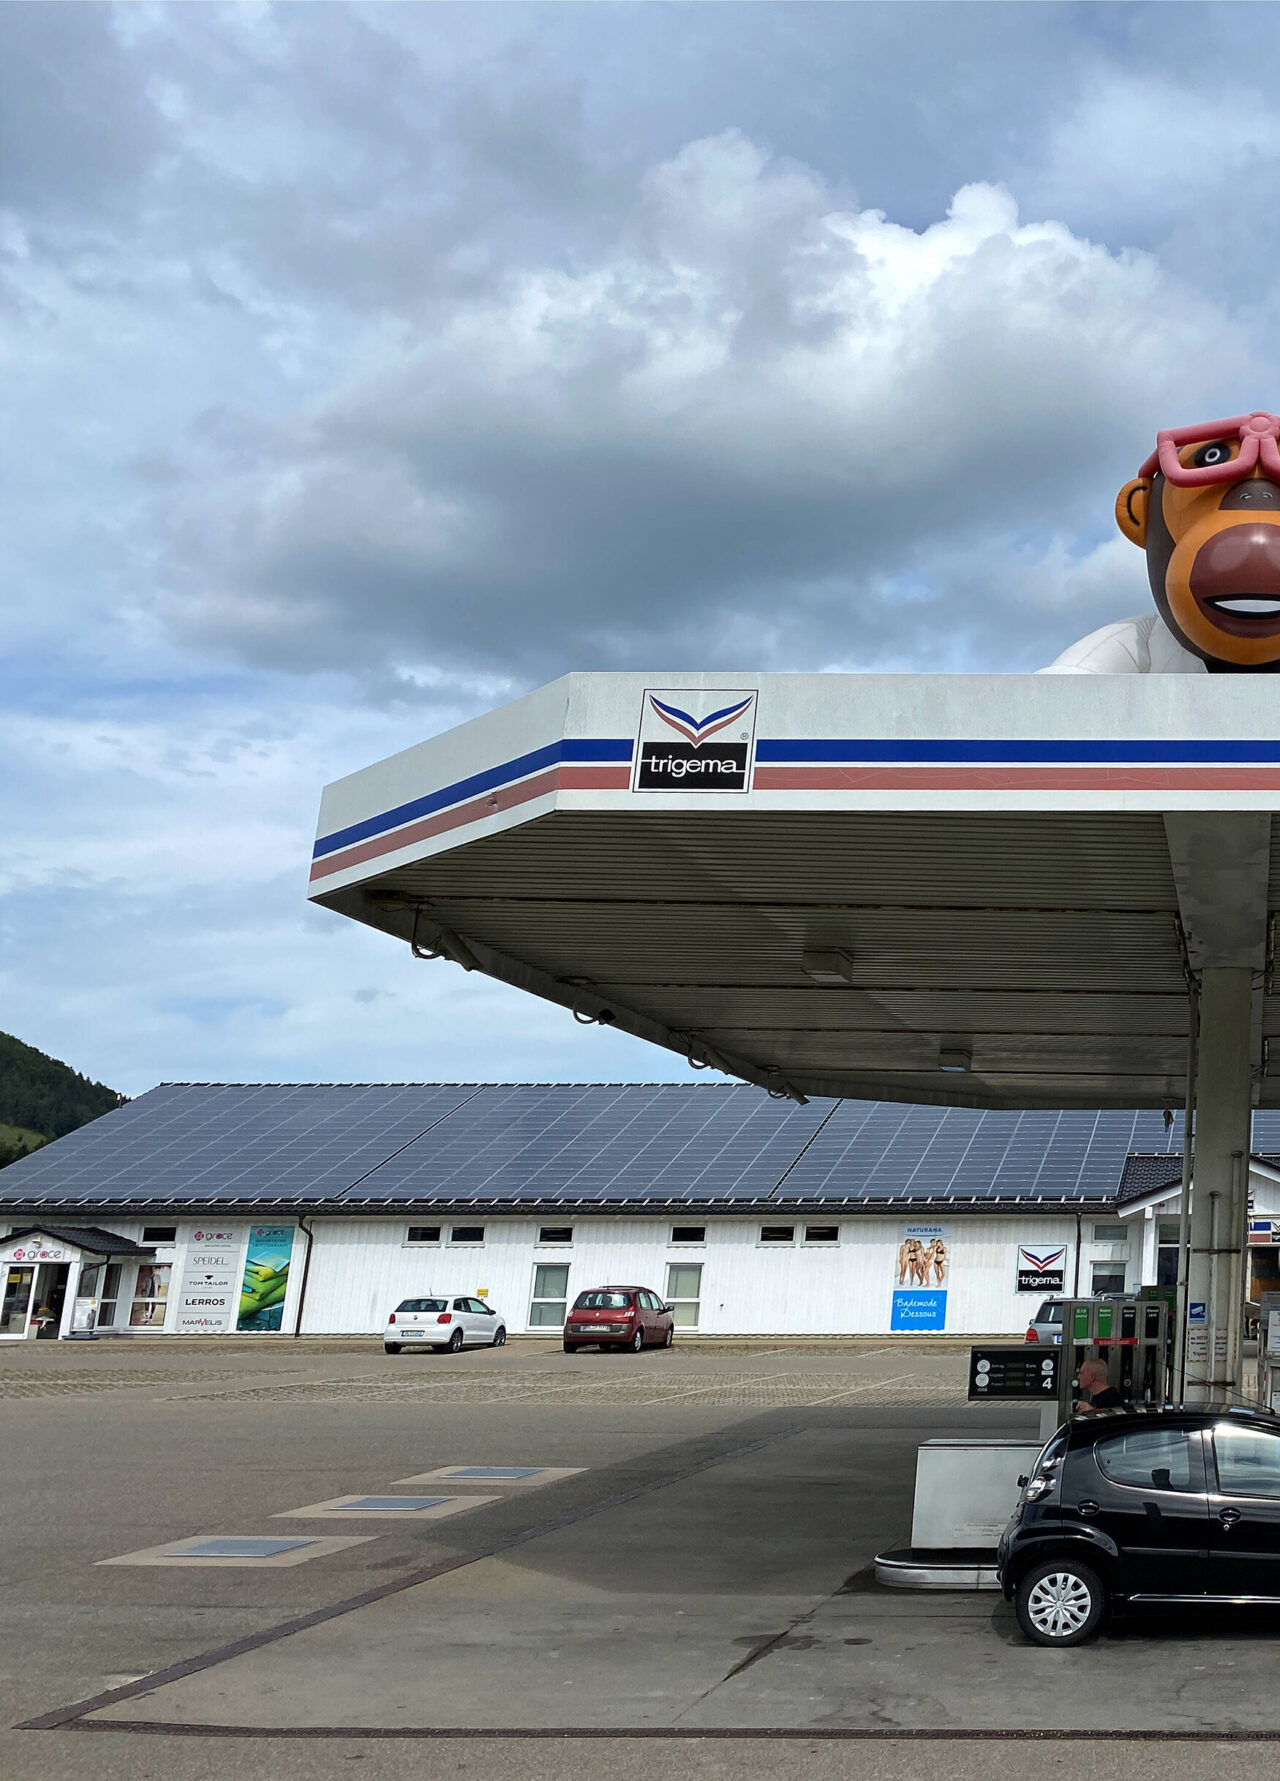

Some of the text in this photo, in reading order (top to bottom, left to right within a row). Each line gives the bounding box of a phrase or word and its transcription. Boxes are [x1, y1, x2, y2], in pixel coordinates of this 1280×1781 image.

[644, 755, 741, 778] trigema
[205, 1231, 233, 1240] grace
[27, 1250, 62, 1260] grace
[1020, 1275, 1061, 1287] trigema
[185, 1298, 226, 1306] LERROS
[895, 1298, 938, 1308] Bademode
[900, 1307, 937, 1319] Dessous
[182, 1318, 223, 1326] MARVELIS
[1042, 1377, 1053, 1390] 4
